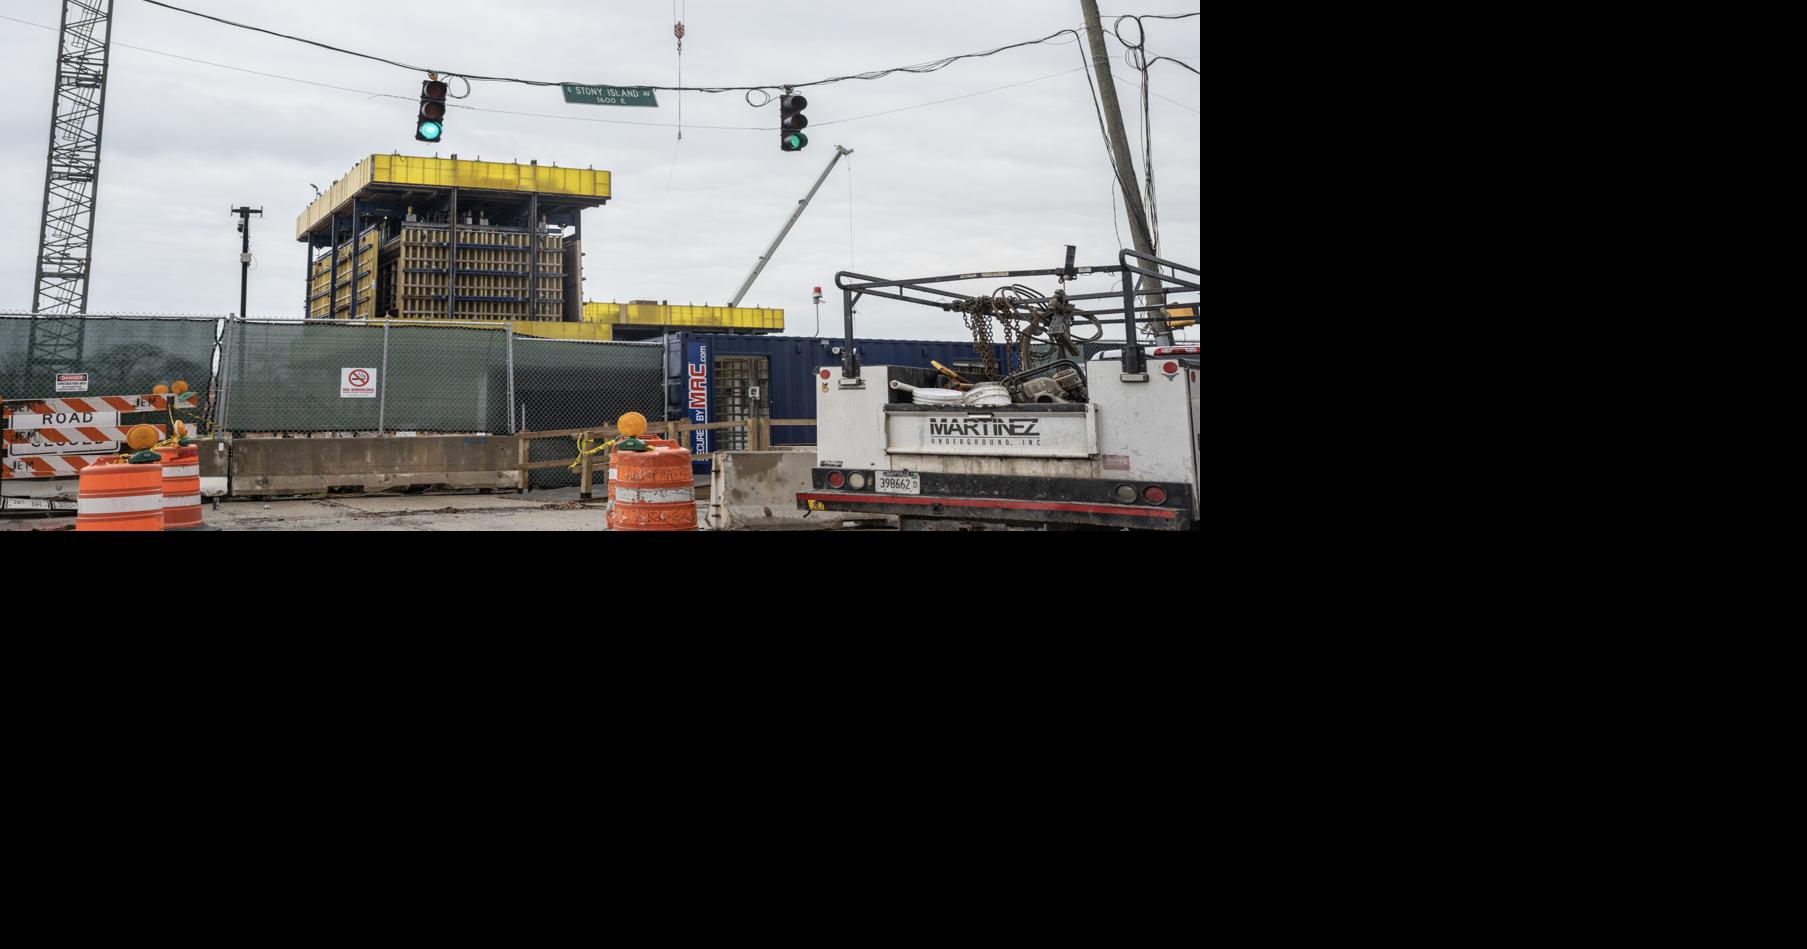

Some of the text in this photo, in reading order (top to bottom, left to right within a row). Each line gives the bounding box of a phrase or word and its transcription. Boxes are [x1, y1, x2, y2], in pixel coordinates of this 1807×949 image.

[575, 87, 603, 96] STONY
[607, 88, 639, 98] ISLAND
[42, 412, 94, 425] ROAD
[695, 410, 704, 422] BY
[929, 418, 1040, 436] MARTINEZ
[9, 460, 33, 472] JEM
[879, 477, 911, 490] 398662
